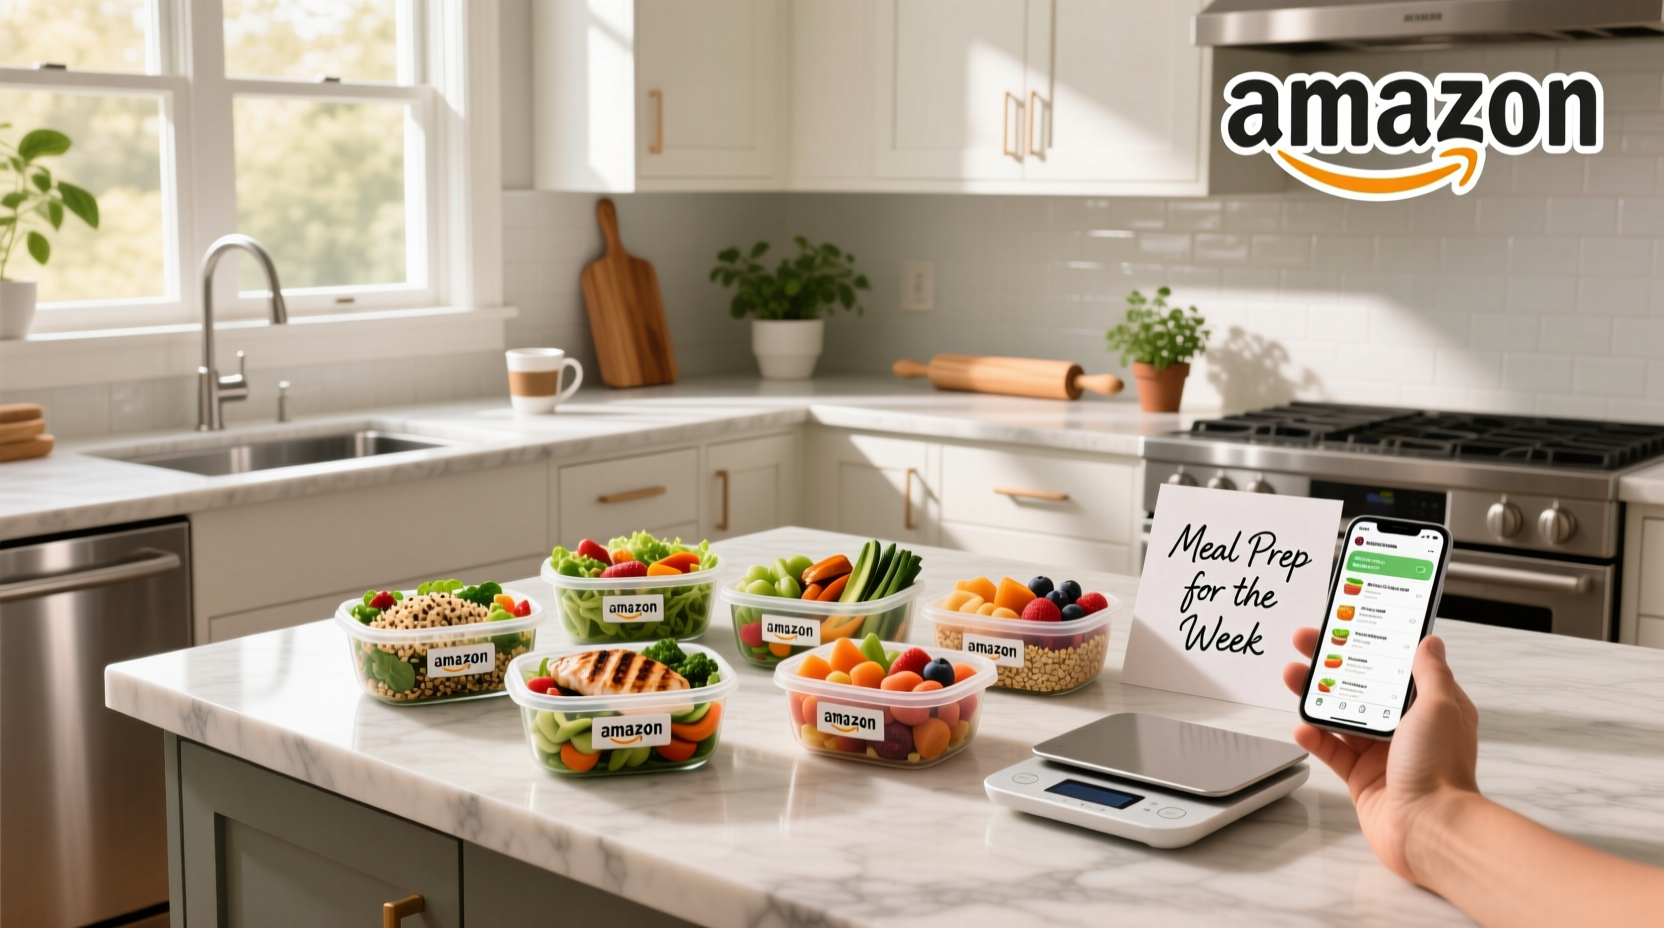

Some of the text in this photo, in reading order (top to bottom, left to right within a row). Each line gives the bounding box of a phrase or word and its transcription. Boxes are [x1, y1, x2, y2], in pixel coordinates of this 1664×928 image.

[1168, 523, 1312, 583] Meal Prep
[1180, 571, 1278, 613] for the
[609, 601, 658, 614] amazon
[767, 621, 813, 638] amazon
[1180, 614, 1264, 655] Week
[434, 650, 488, 669] amazon
[968, 641, 1017, 659] amazon
[824, 709, 876, 730] amazon
[601, 721, 663, 739] amazon
